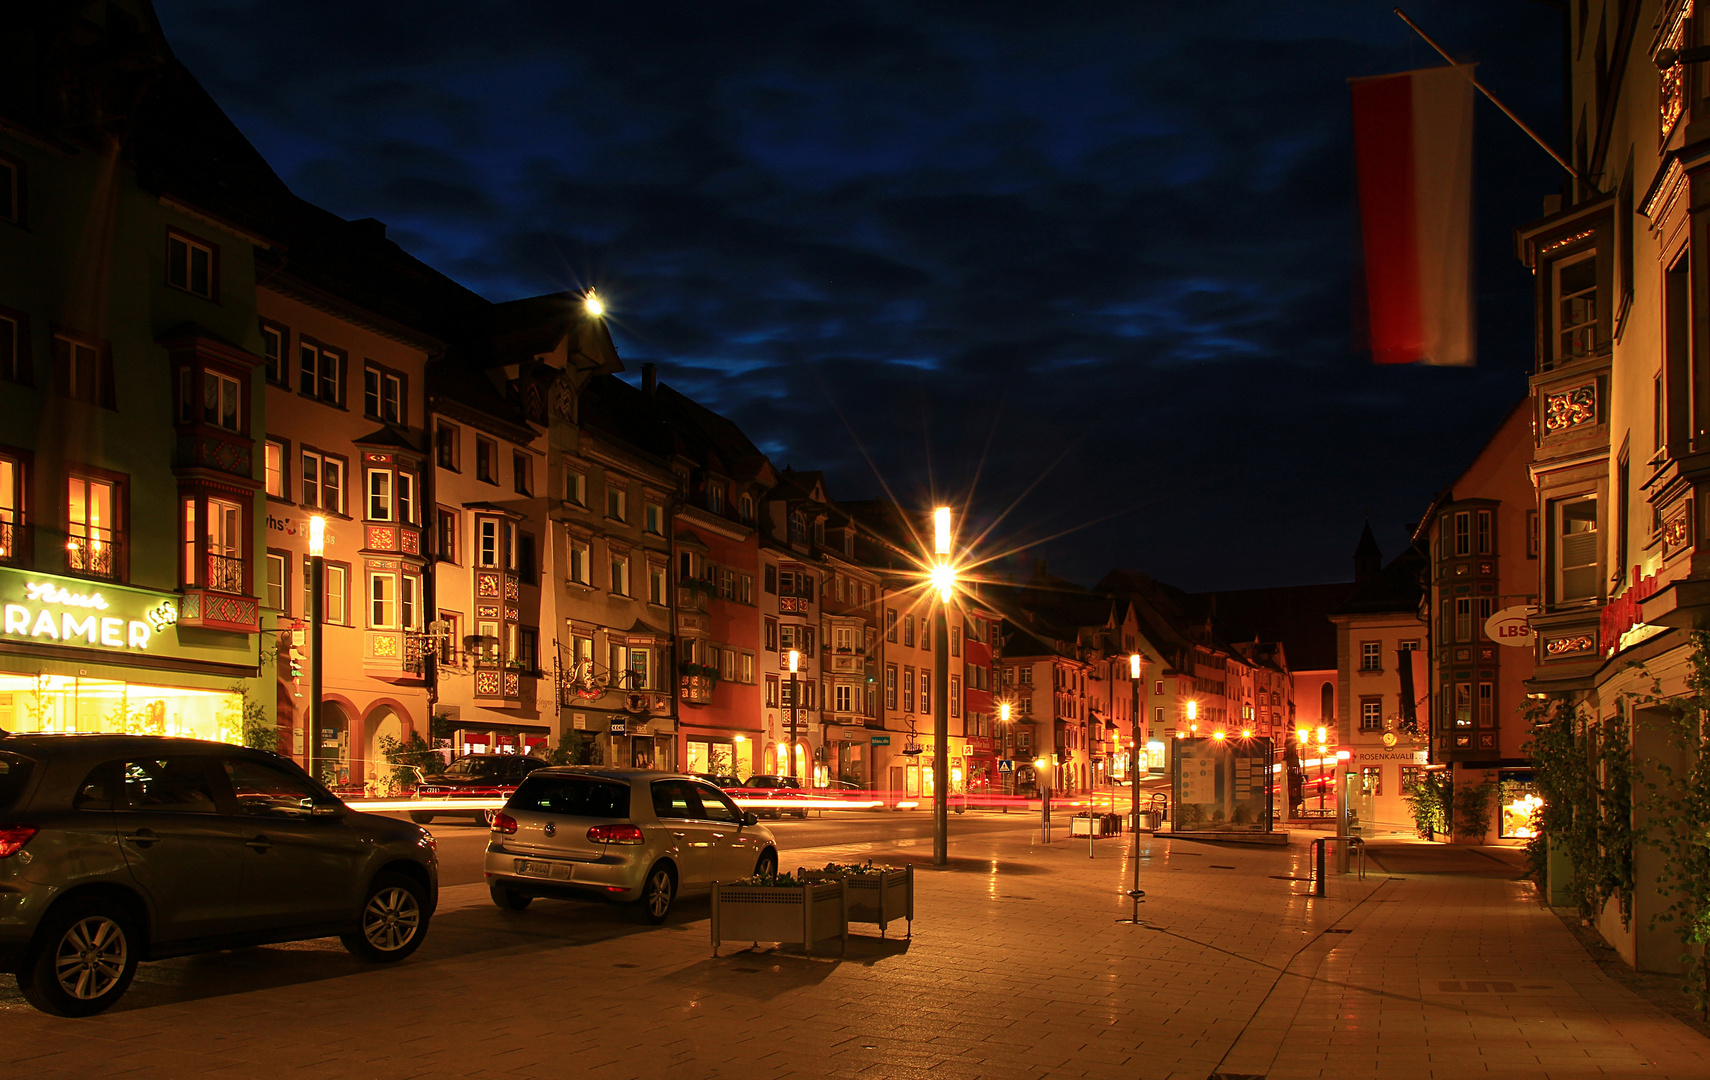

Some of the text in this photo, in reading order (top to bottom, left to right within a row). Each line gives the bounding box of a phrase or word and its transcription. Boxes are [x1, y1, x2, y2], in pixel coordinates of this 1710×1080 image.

[4, 604, 150, 649] RAMER
[1499, 625, 1529, 638] LBS
[611, 724, 625, 732] CECIL
